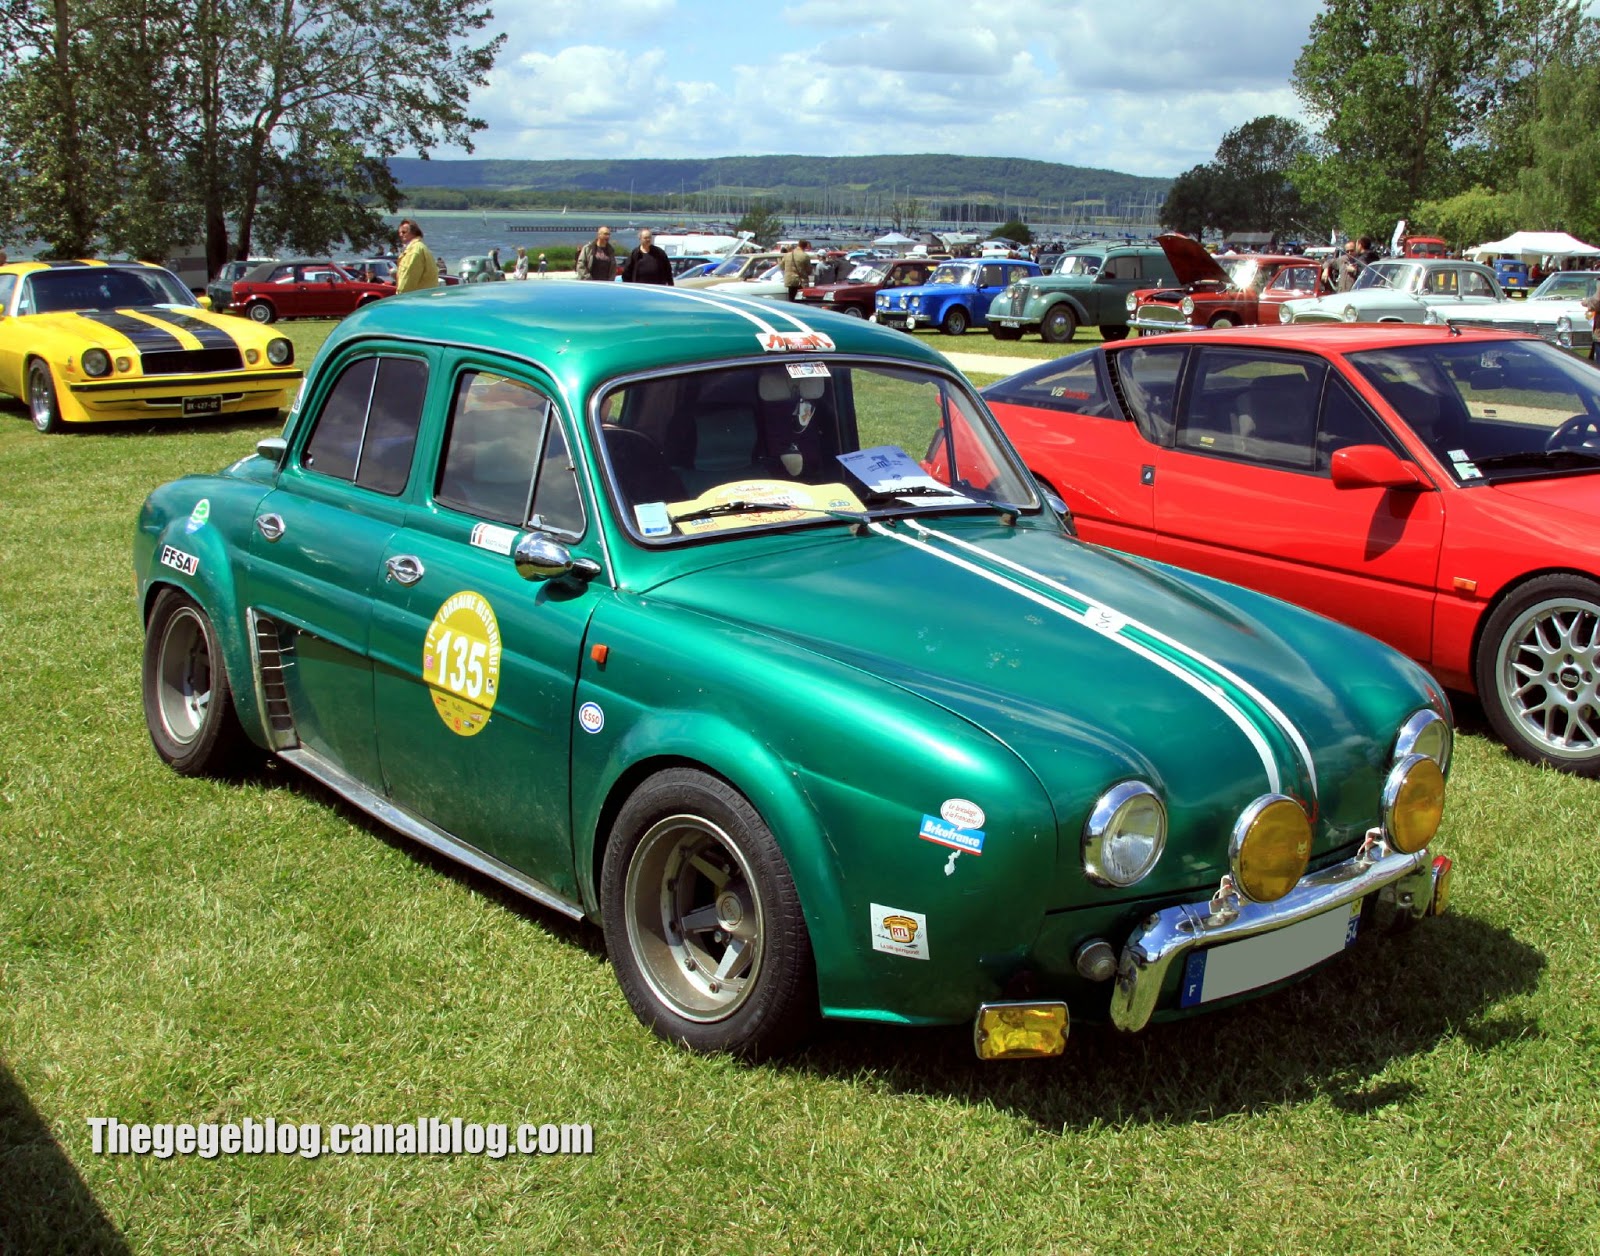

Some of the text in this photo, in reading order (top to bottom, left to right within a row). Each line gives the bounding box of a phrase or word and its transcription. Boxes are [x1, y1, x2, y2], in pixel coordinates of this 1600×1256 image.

[1051, 386, 1066, 397] V6
[162, 546, 194, 573] FFSA
[439, 594, 477, 624] LORRAINE
[475, 600, 499, 675] HISTORIQUE
[436, 630, 487, 699] 135
[923, 820, 980, 848] Bricofrance
[892, 927, 908, 937] RTL
[1188, 984, 1197, 998] F
